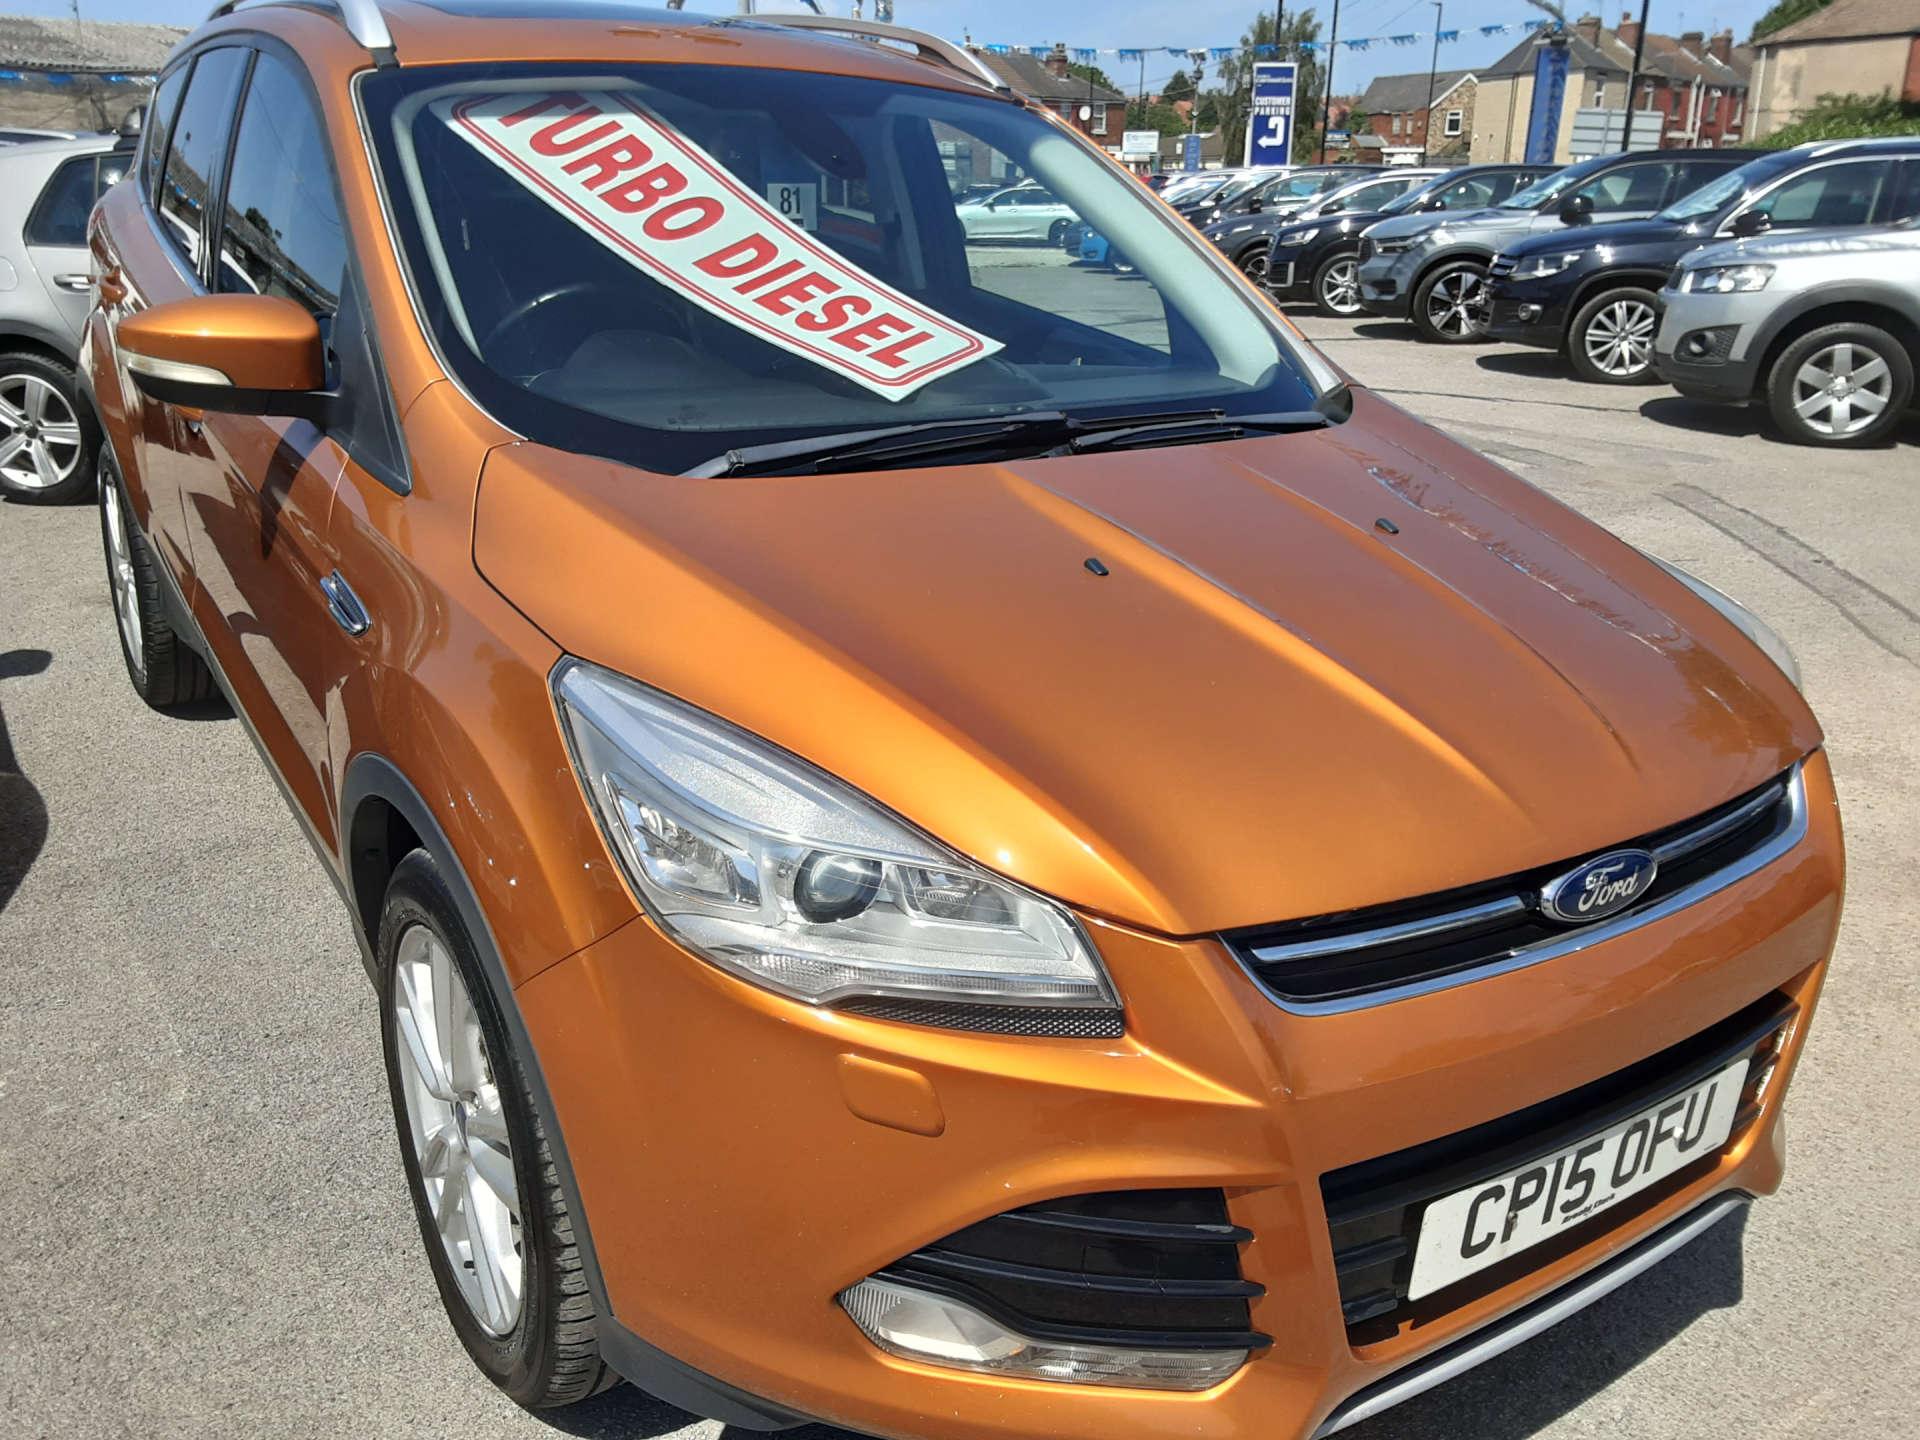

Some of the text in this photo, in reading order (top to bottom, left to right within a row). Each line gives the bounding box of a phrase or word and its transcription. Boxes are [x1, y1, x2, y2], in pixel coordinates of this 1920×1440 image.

[1254, 106, 1291, 116] PARKING
[1255, 96, 1291, 106] CUSTOMER
[780, 186, 801, 215] 81
[497, 90, 935, 368] TURBO DIESEL
[1577, 867, 1640, 912] Ford
[1460, 1081, 1718, 1260] CP15 OFU
